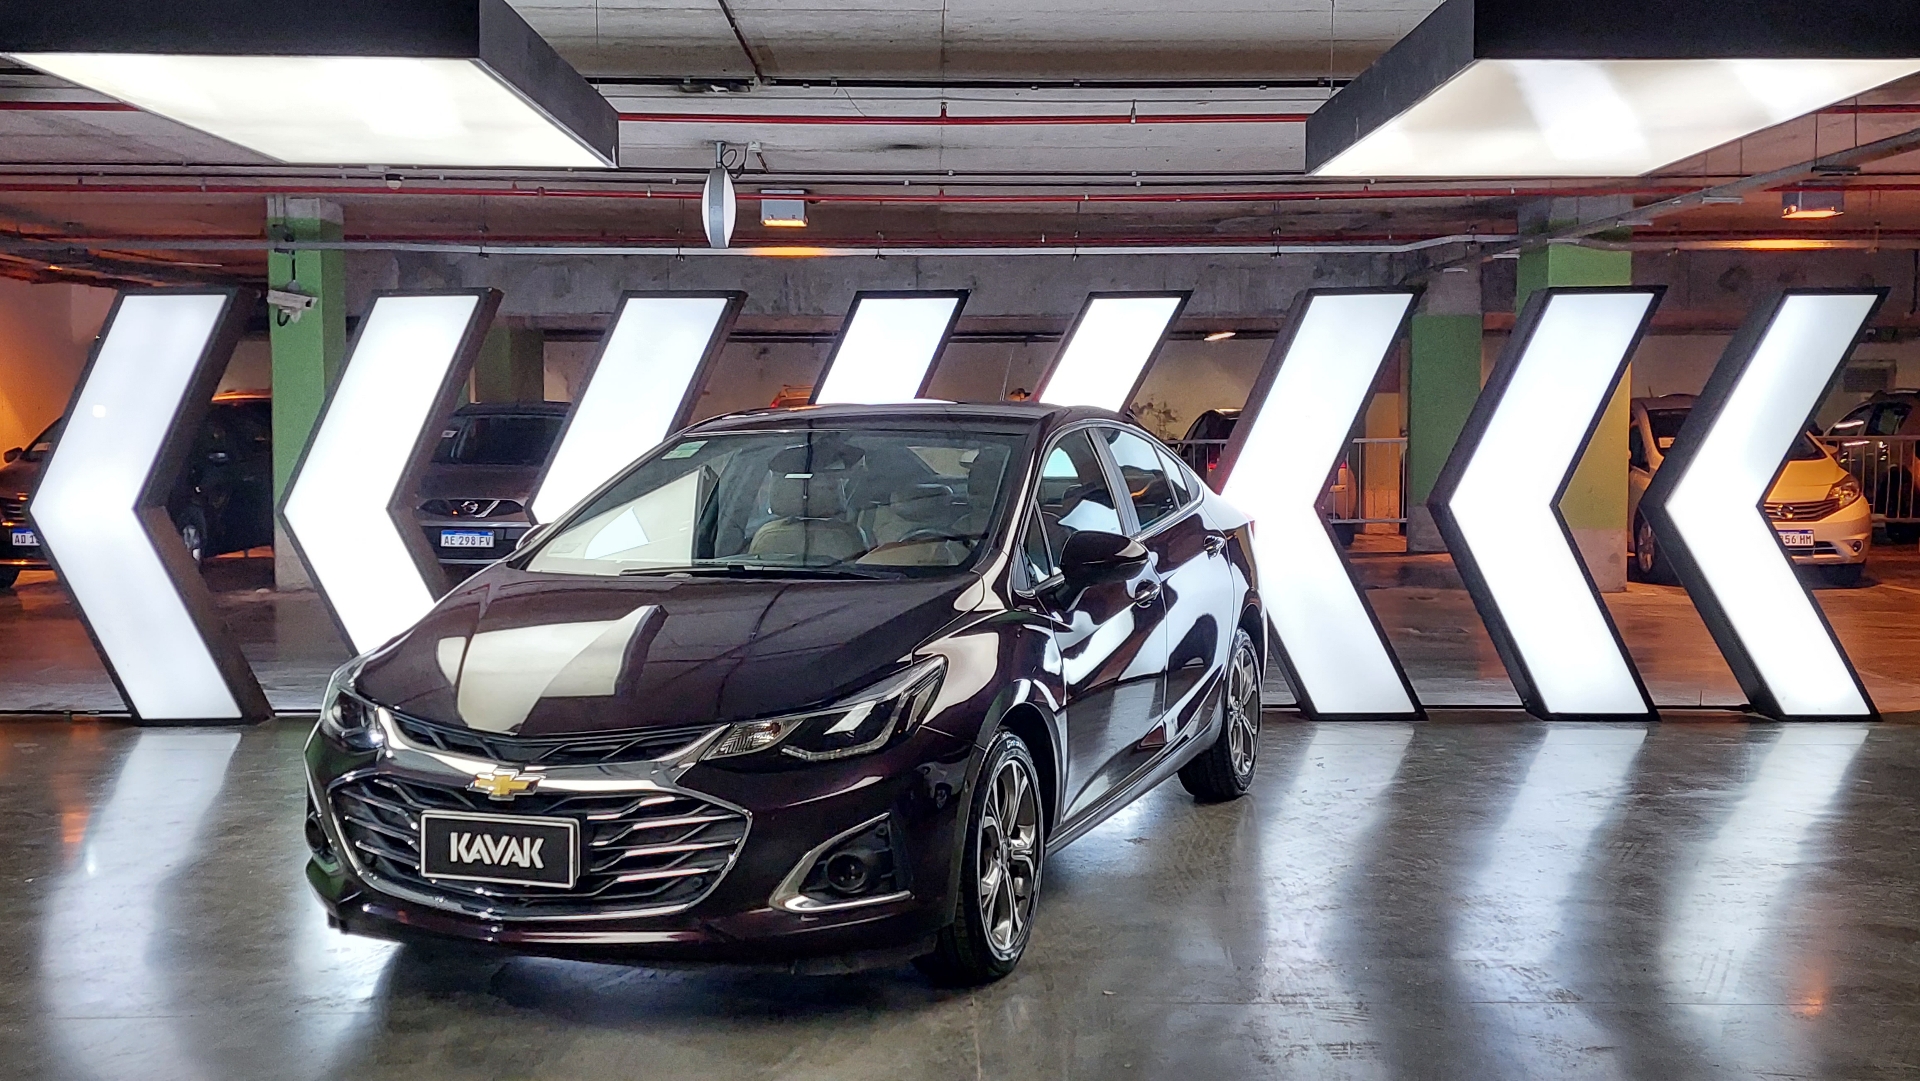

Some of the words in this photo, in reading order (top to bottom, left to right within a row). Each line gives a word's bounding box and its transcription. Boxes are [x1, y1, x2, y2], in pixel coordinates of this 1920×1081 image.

[15, 535, 26, 544] AD
[444, 536, 456, 546] AE
[458, 536, 476, 546] 298
[479, 536, 491, 546] FV
[1799, 535, 1812, 545] HM
[450, 832, 545, 869] KAVAK
